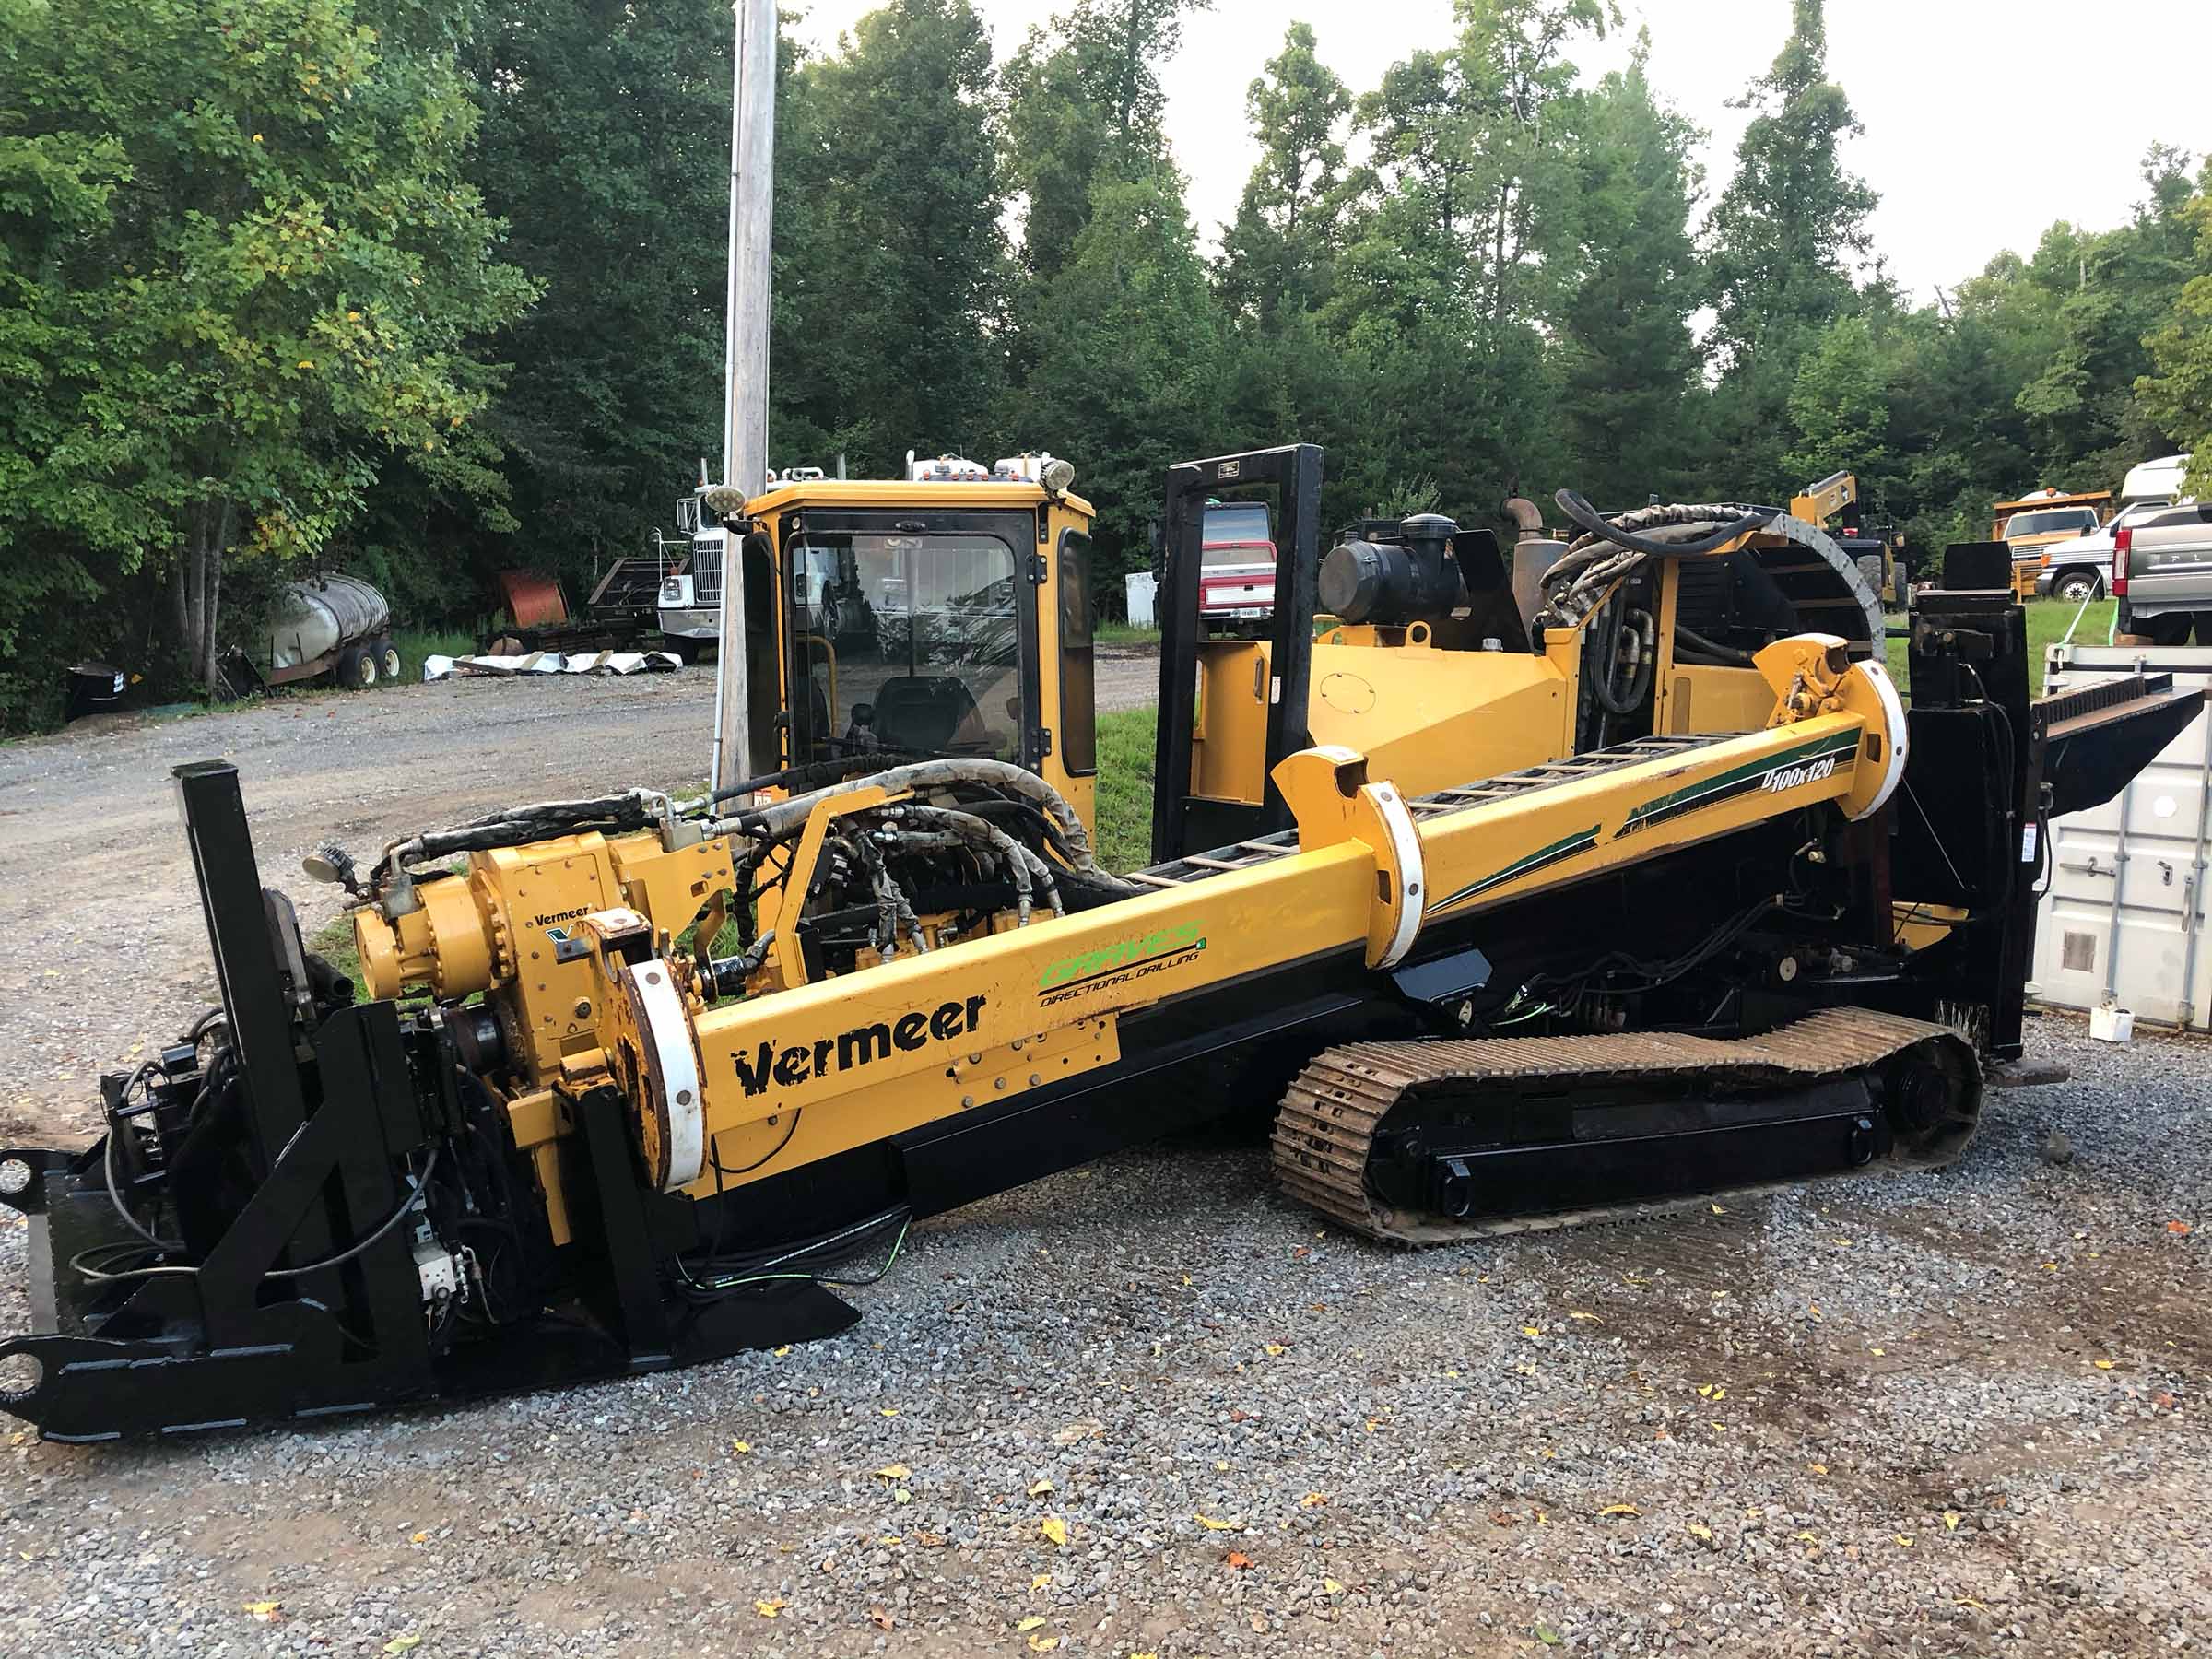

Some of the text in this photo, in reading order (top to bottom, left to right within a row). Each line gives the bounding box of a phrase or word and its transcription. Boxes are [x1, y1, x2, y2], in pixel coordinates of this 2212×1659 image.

[1760, 758, 1836, 793] D100x120
[535, 906, 589, 926] Vermeer
[1040, 951, 1200, 1007] DIRECTIONAL DRILLING
[730, 994, 987, 1099] Vermeer
